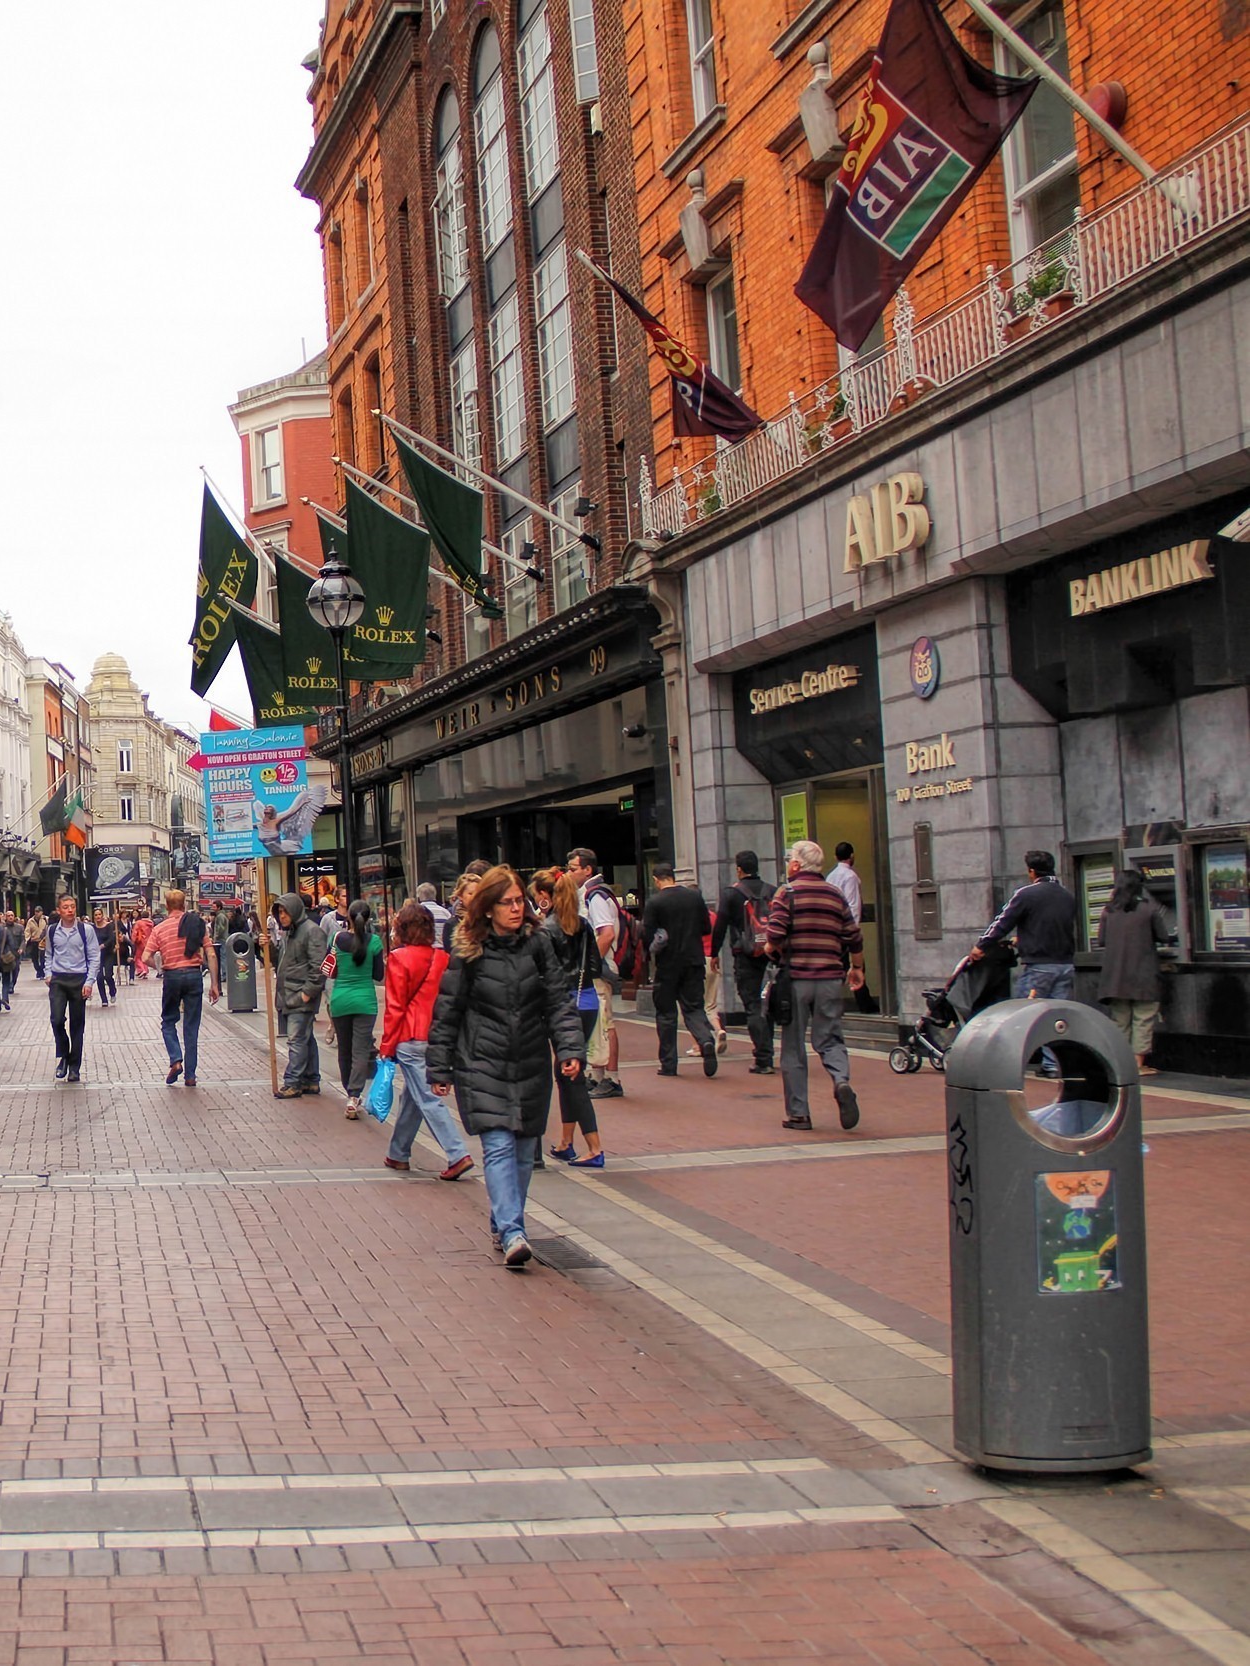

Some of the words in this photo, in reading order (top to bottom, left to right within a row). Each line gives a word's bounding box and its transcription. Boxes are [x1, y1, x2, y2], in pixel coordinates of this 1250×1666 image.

[842, 472, 931, 575] AIB
[1069, 538, 1216, 618] BANKLINK
[353, 623, 418, 645] ROLEX
[589, 645, 608, 677] 99
[433, 703, 481, 741] WEIR
[504, 665, 563, 713] SONS
[749, 684, 801, 715] Service
[801, 664, 855, 699] Centre
[206, 754, 225, 765] NOW
[225, 754, 242, 764] OPEN
[248, 751, 278, 761] GRAFTON
[278, 749, 302, 759] STREET
[905, 732, 956, 775] Bank
[208, 767, 251, 781] HAPPY
[209, 779, 253, 793] HOURS
[946, 777, 974, 794] Street
[263, 783, 308, 795] TANNING
